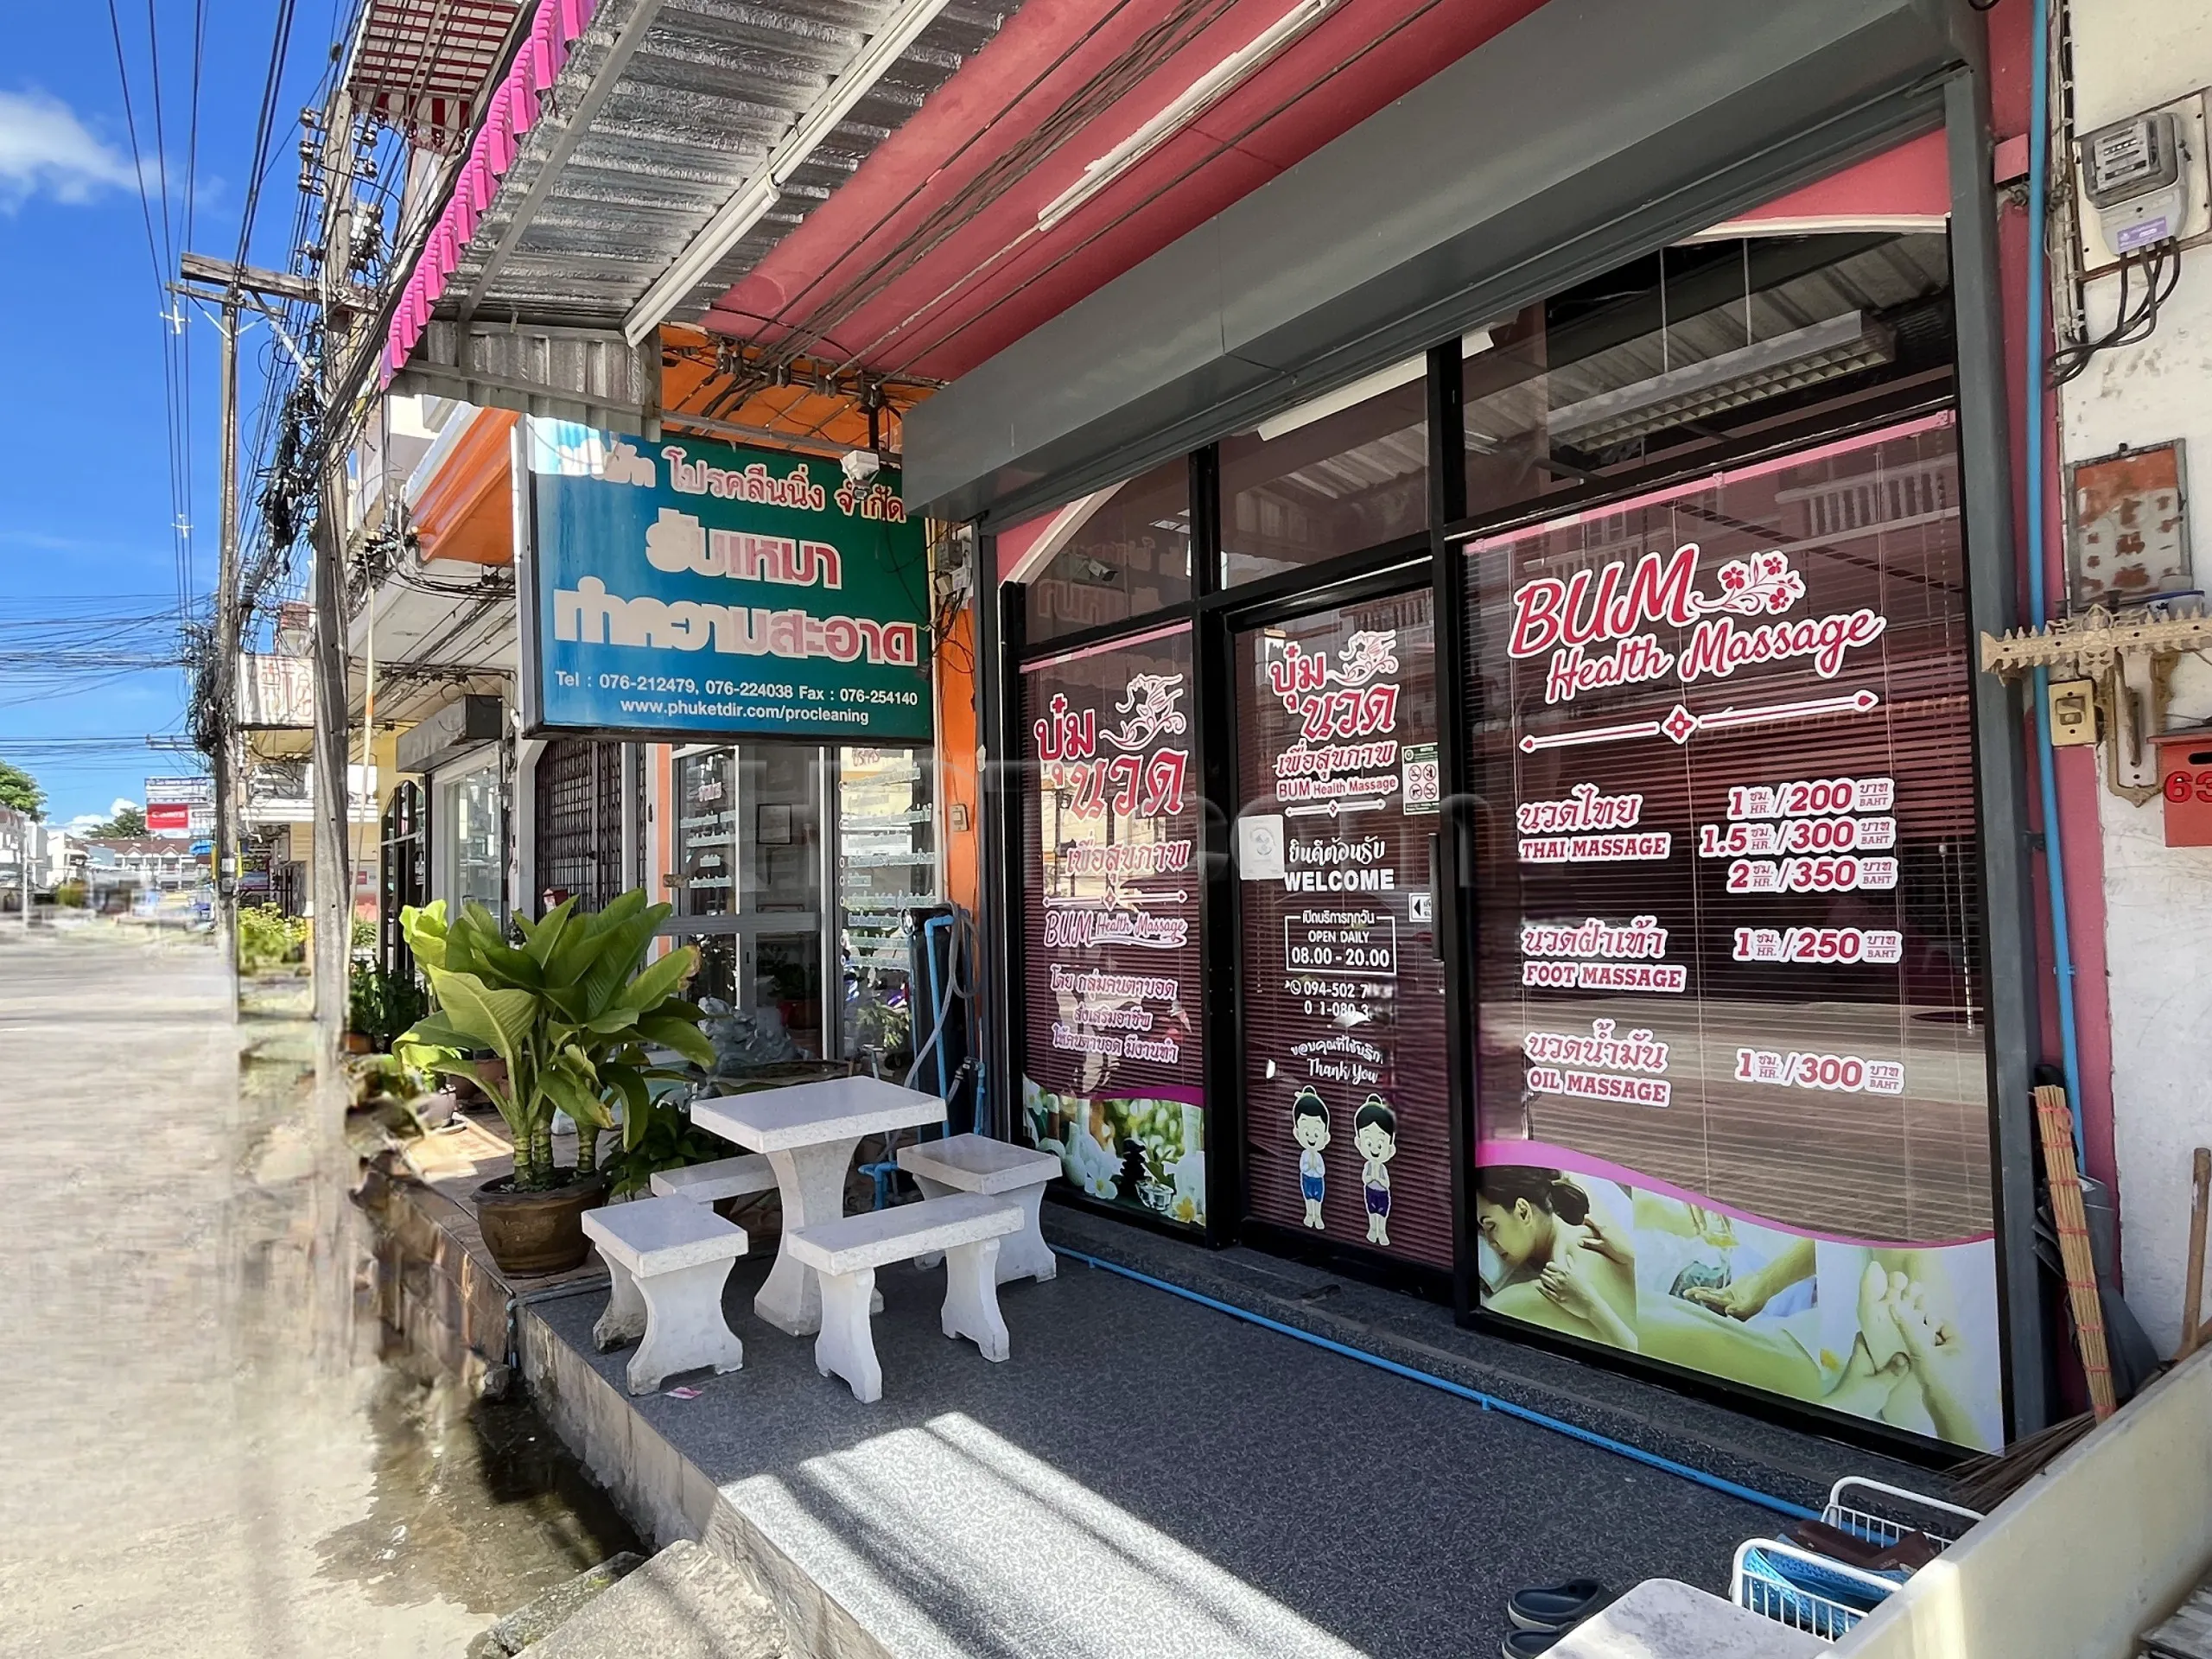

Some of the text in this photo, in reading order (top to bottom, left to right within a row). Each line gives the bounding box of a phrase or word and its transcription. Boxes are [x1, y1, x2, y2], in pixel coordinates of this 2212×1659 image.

[662, 446, 826, 511] โปรคลีนนิ่ง
[1509, 544, 1698, 658] BUM
[1547, 611, 1885, 702] Health Massage
[556, 671, 580, 688] Tel
[599, 674, 699, 696] 076-212479,
[705, 680, 793, 699] 076-224038
[798, 685, 824, 702] Fax
[840, 688, 918, 707] 076-254140
[620, 697, 868, 726] www.phuketdir.com/procleaning
[1301, 685, 1398, 740] นวด
[1277, 740, 1396, 779] เพื่อสุขภาพ
[1070, 748, 1187, 819] นวด
[1277, 778, 1396, 799] BUM Health Massage
[1519, 786, 1640, 831] นวดไทย
[1859, 798, 1889, 807] BAHT
[1288, 835, 1386, 867] ยินดีต้อนรับ
[1522, 836, 1669, 860] THAI MASSAGE
[1703, 827, 1747, 853] 1.5
[1861, 836, 1891, 845] BAHT
[1284, 868, 1395, 892] WELCOME
[1731, 863, 1750, 888] 2
[1863, 876, 1892, 885] BAHT
[1045, 912, 1187, 946] BUM Health Massage
[1307, 930, 1370, 944] OPEN DAILY
[1291, 947, 1332, 965] 08.00
[1345, 949, 1390, 967] 20.00
[1867, 950, 1897, 958] BAHT
[1525, 964, 1683, 988] FOOT MASSAGE
[1527, 1020, 1666, 1070] นวดน้ำมัน
[1307, 1058, 1378, 1085] Thank You
[1870, 1079, 1899, 1090] BAHT
[1529, 1070, 1668, 1103] OIL MASSAGE
